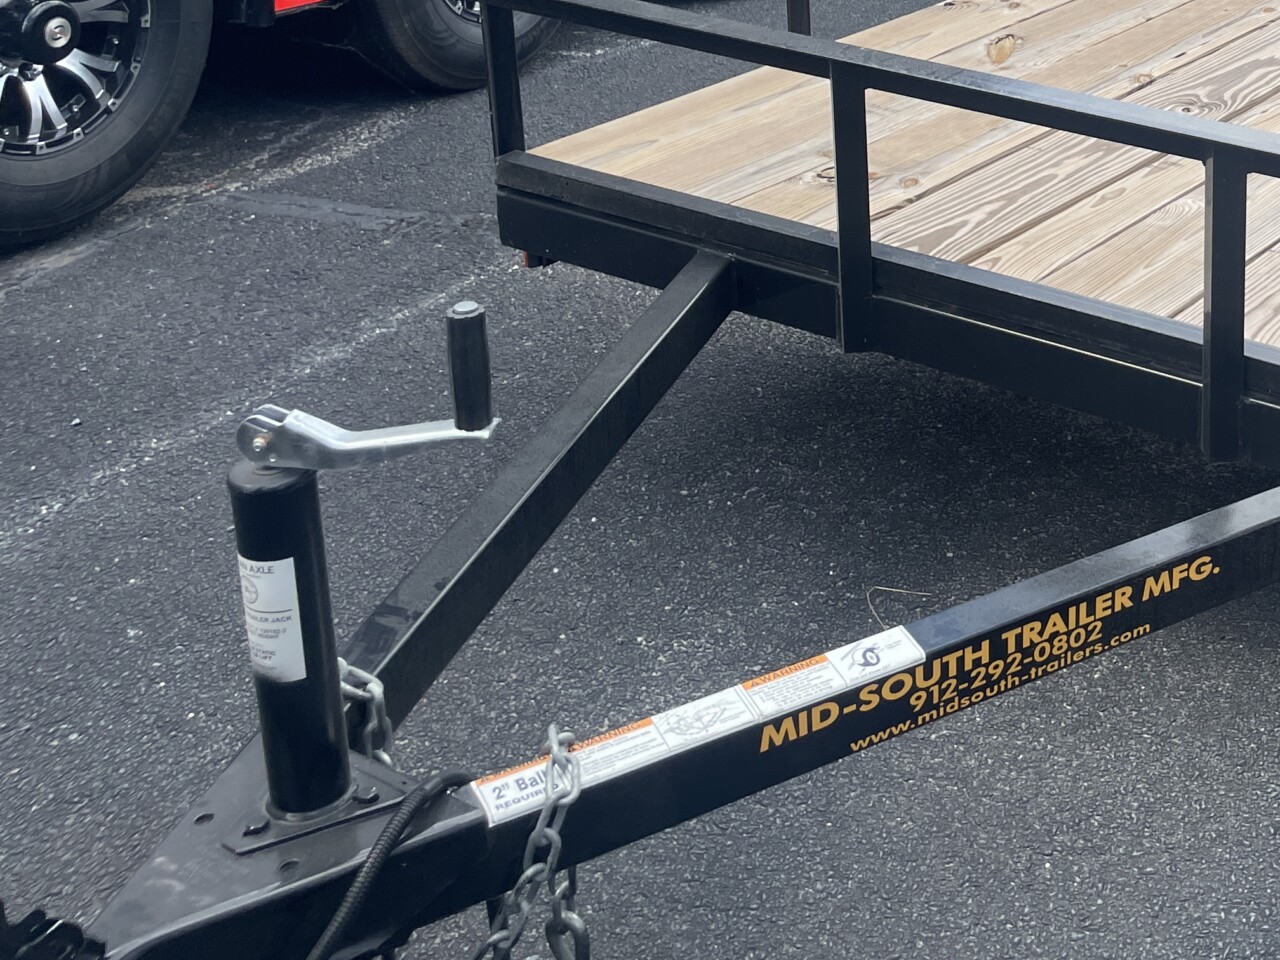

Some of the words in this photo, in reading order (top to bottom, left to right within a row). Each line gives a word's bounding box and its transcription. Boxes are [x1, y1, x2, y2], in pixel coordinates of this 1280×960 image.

[249, 565, 274, 574] AXLE
[760, 639, 990, 753] MID-SOUTH
[1002, 586, 1133, 654] TRAILER
[1142, 556, 1220, 602] MFG.
[760, 657, 818, 683] WARNING
[851, 624, 1150, 751] www.midsouth-trailers.com
[910, 621, 1103, 712] 912-292-0802
